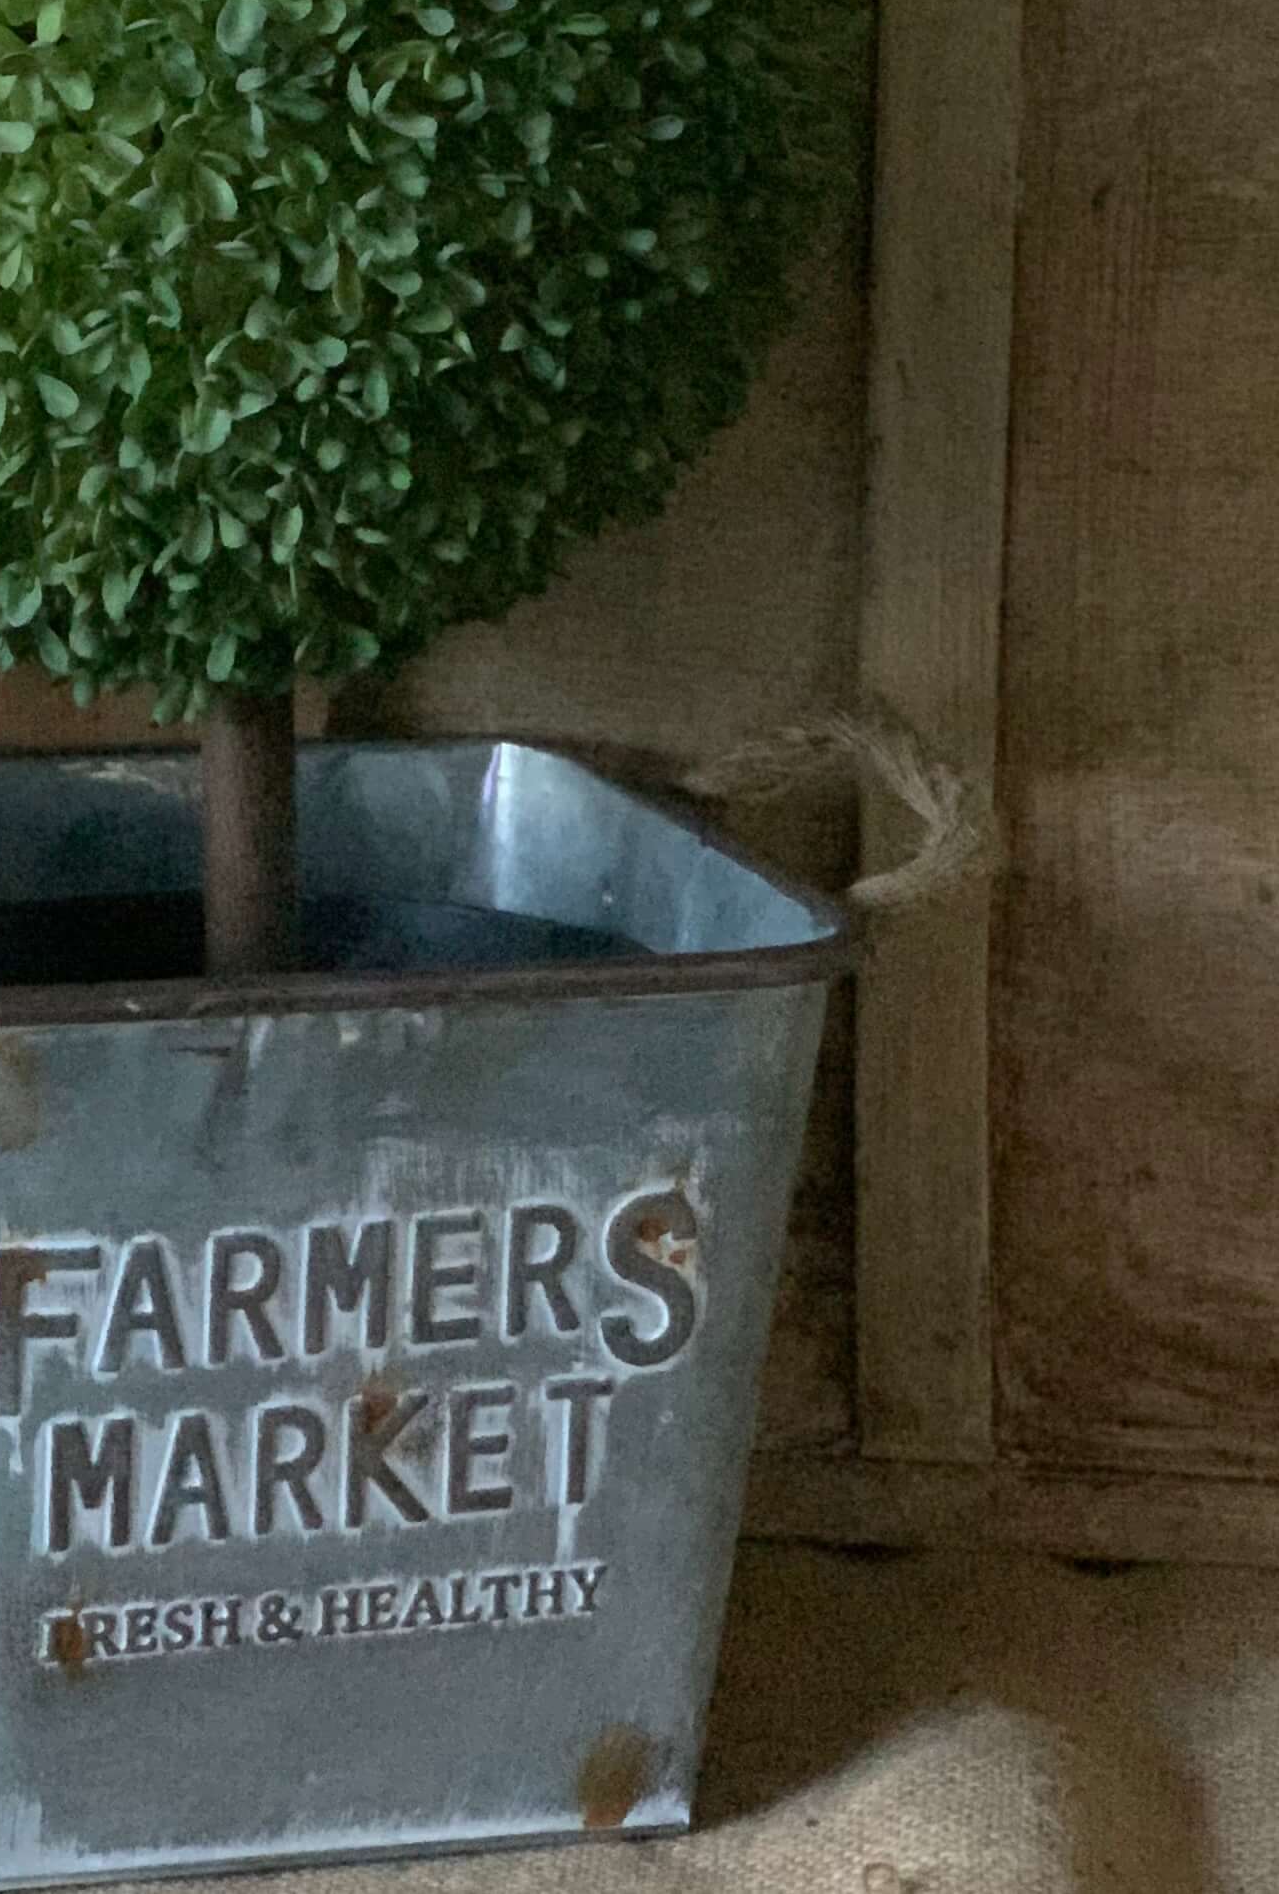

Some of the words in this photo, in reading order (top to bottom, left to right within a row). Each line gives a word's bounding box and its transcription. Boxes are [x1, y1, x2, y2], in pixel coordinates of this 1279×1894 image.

[45, 1376, 614, 1552] MARKET
[257, 1594, 303, 1642] &
[318, 1565, 607, 1636] HEALTHY
